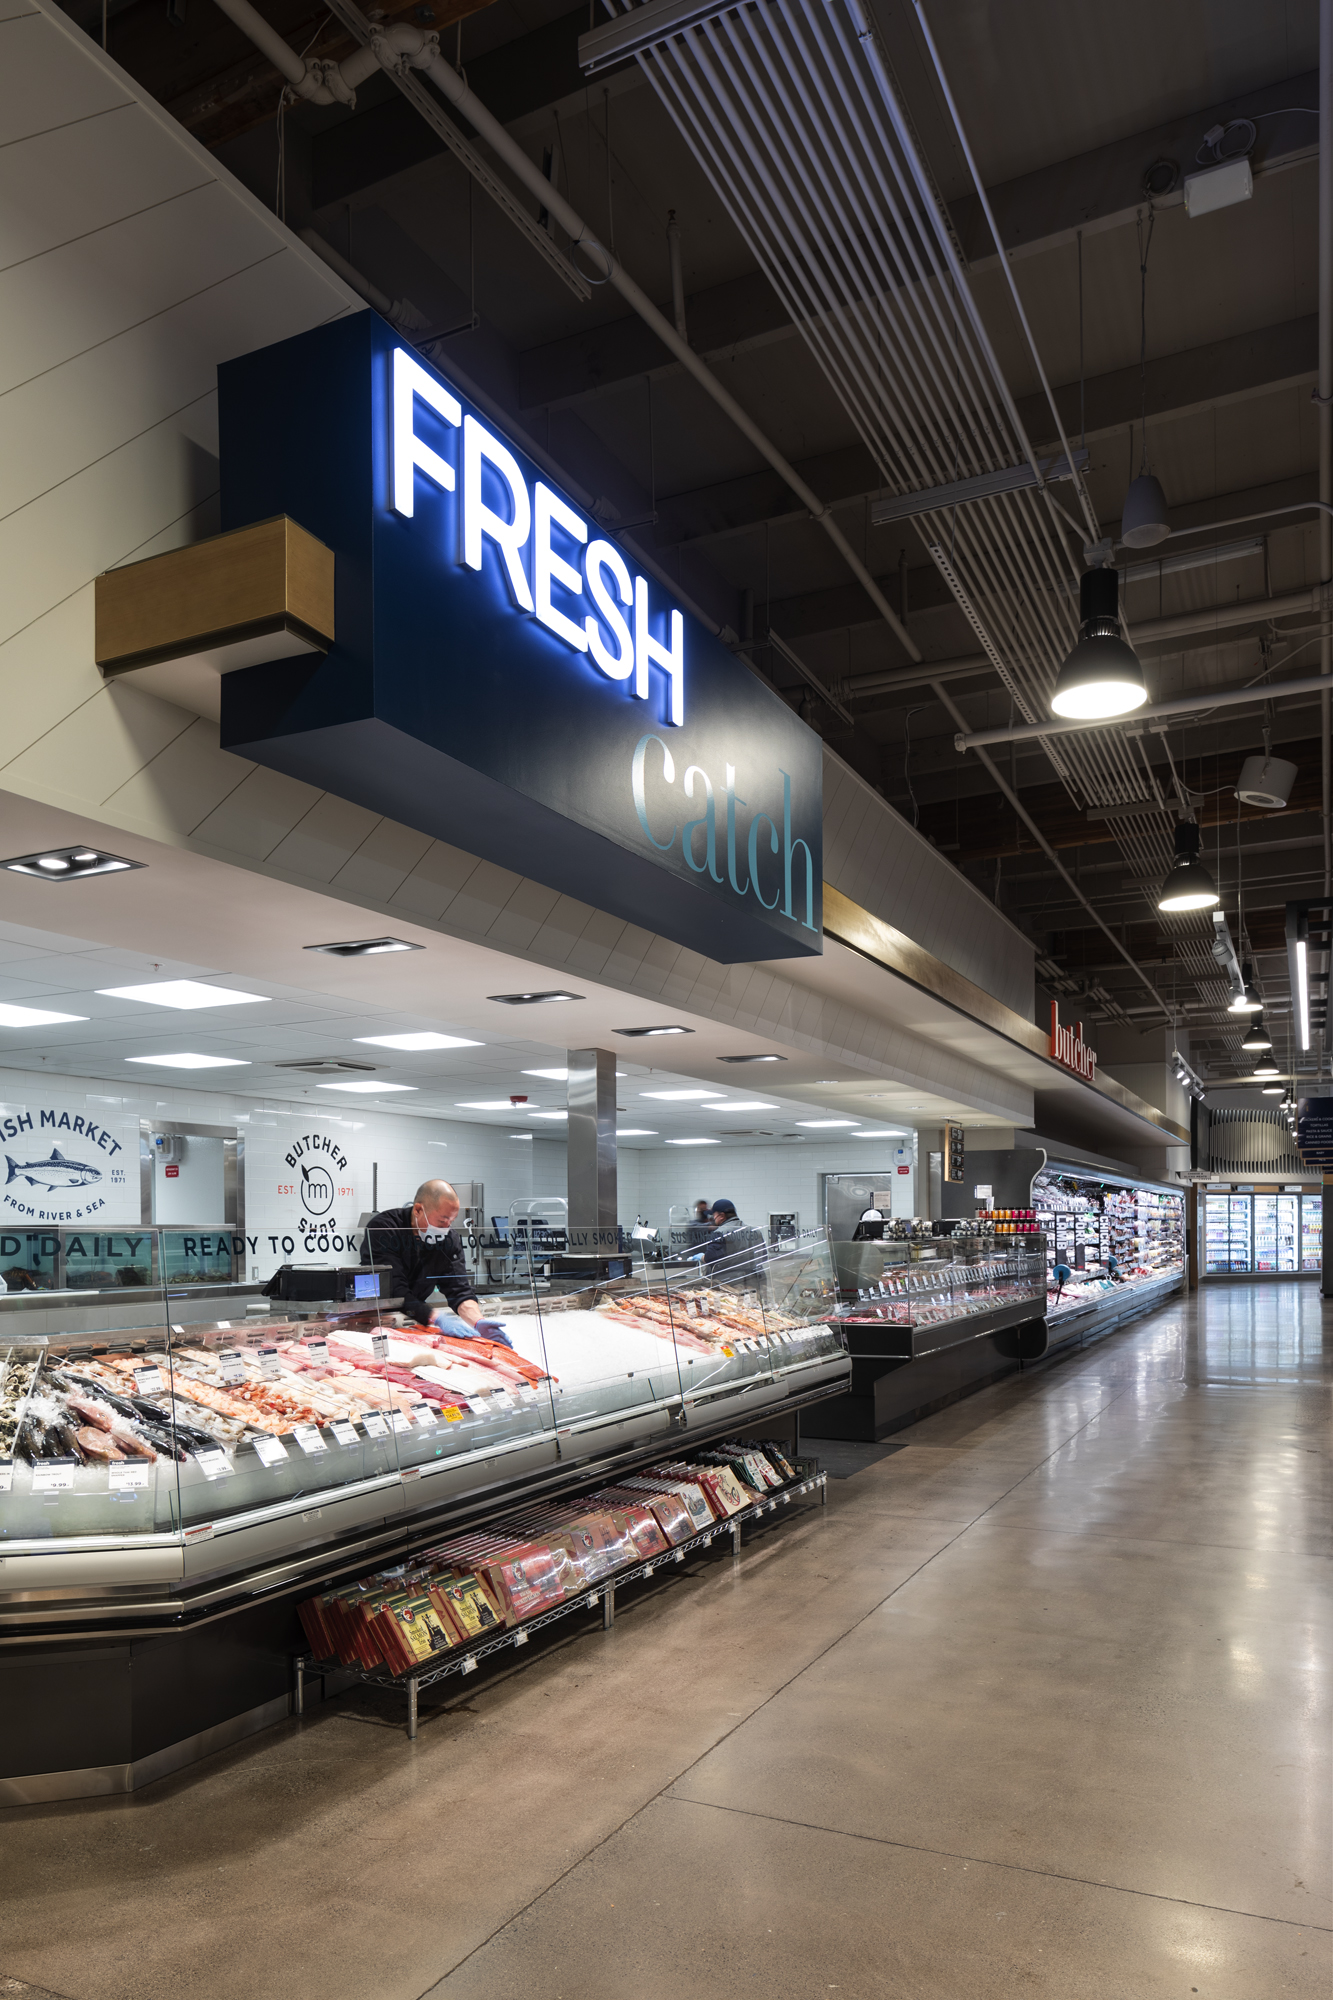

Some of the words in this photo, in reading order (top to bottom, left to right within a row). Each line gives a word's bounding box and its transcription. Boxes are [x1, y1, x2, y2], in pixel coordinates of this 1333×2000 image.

[390, 346, 684, 727] FRESH
[631, 733, 819, 933] Catch
[1050, 1000, 1097, 1081] butcher
[40, 1109, 122, 1157] MARKET
[284, 1134, 348, 1172] BUTCHER
[277, 1184, 296, 1195] EST.
[337, 1187, 354, 1196] 1971
[3, 1194, 35, 1217] FROM
[38, 1210, 72, 1221] RIVER
[76, 1208, 83, 1218] &
[86, 1198, 106, 1214] SEA
[298, 1217, 337, 1239] SHOP
[380, 1234, 454, 1251] SOURCED
[460, 1233, 517, 1249] LOCALLY
[593, 1232, 633, 1246] SMOKED
[1056, 1214, 1067, 1250] LAMB
[1075, 1214, 1085, 1246] PORK
[1100, 1215, 1110, 1260] CHICKEN
[40, 1236, 144, 1257] DAILY
[183, 1236, 259, 1257] READY
[268, 1235, 295, 1254] TO
[304, 1234, 358, 1253] COOK
